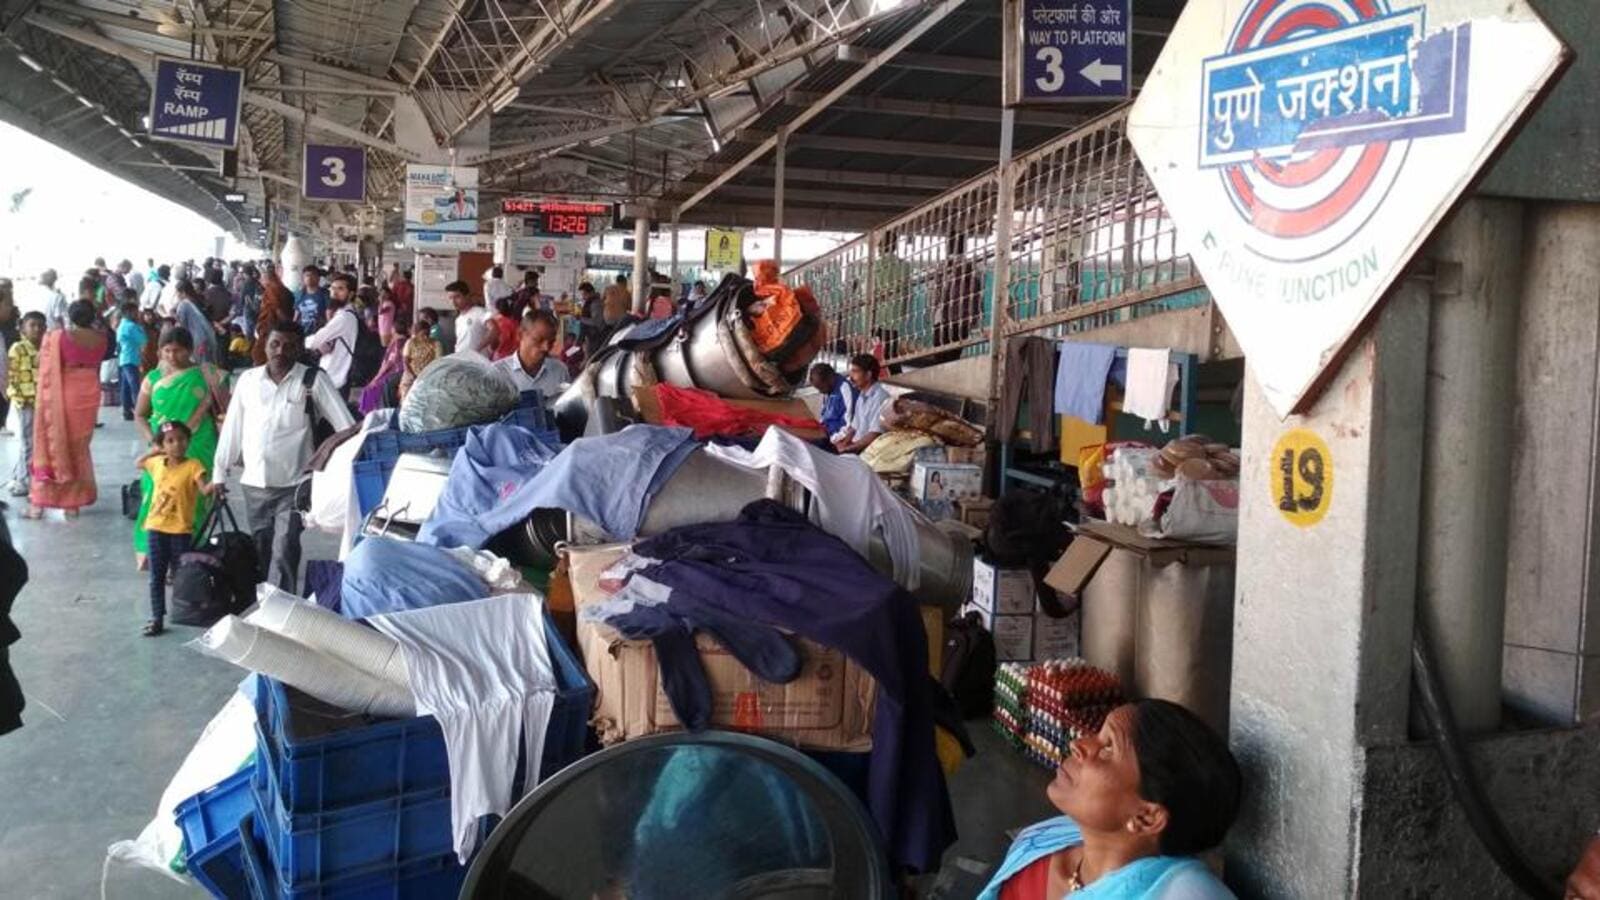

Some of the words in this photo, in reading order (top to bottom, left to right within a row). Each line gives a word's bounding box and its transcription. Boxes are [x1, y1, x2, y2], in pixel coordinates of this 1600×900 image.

[1081, 4, 1096, 25] की
[1099, 4, 1121, 26] ओर
[1029, 30, 1052, 46] WAY
[1054, 30, 1069, 45] TO
[1071, 30, 1126, 47] PLATFORM
[1035, 46, 1065, 92] 3
[164, 102, 209, 119] RAMP
[1213, 66, 1266, 149] पुणे
[1276, 54, 1407, 121] जंक्शन
[320, 157, 347, 187] 3
[548, 214, 587, 233] 13:26
[1278, 246, 1379, 304] UNCTION
[1279, 447, 1324, 513] 19
